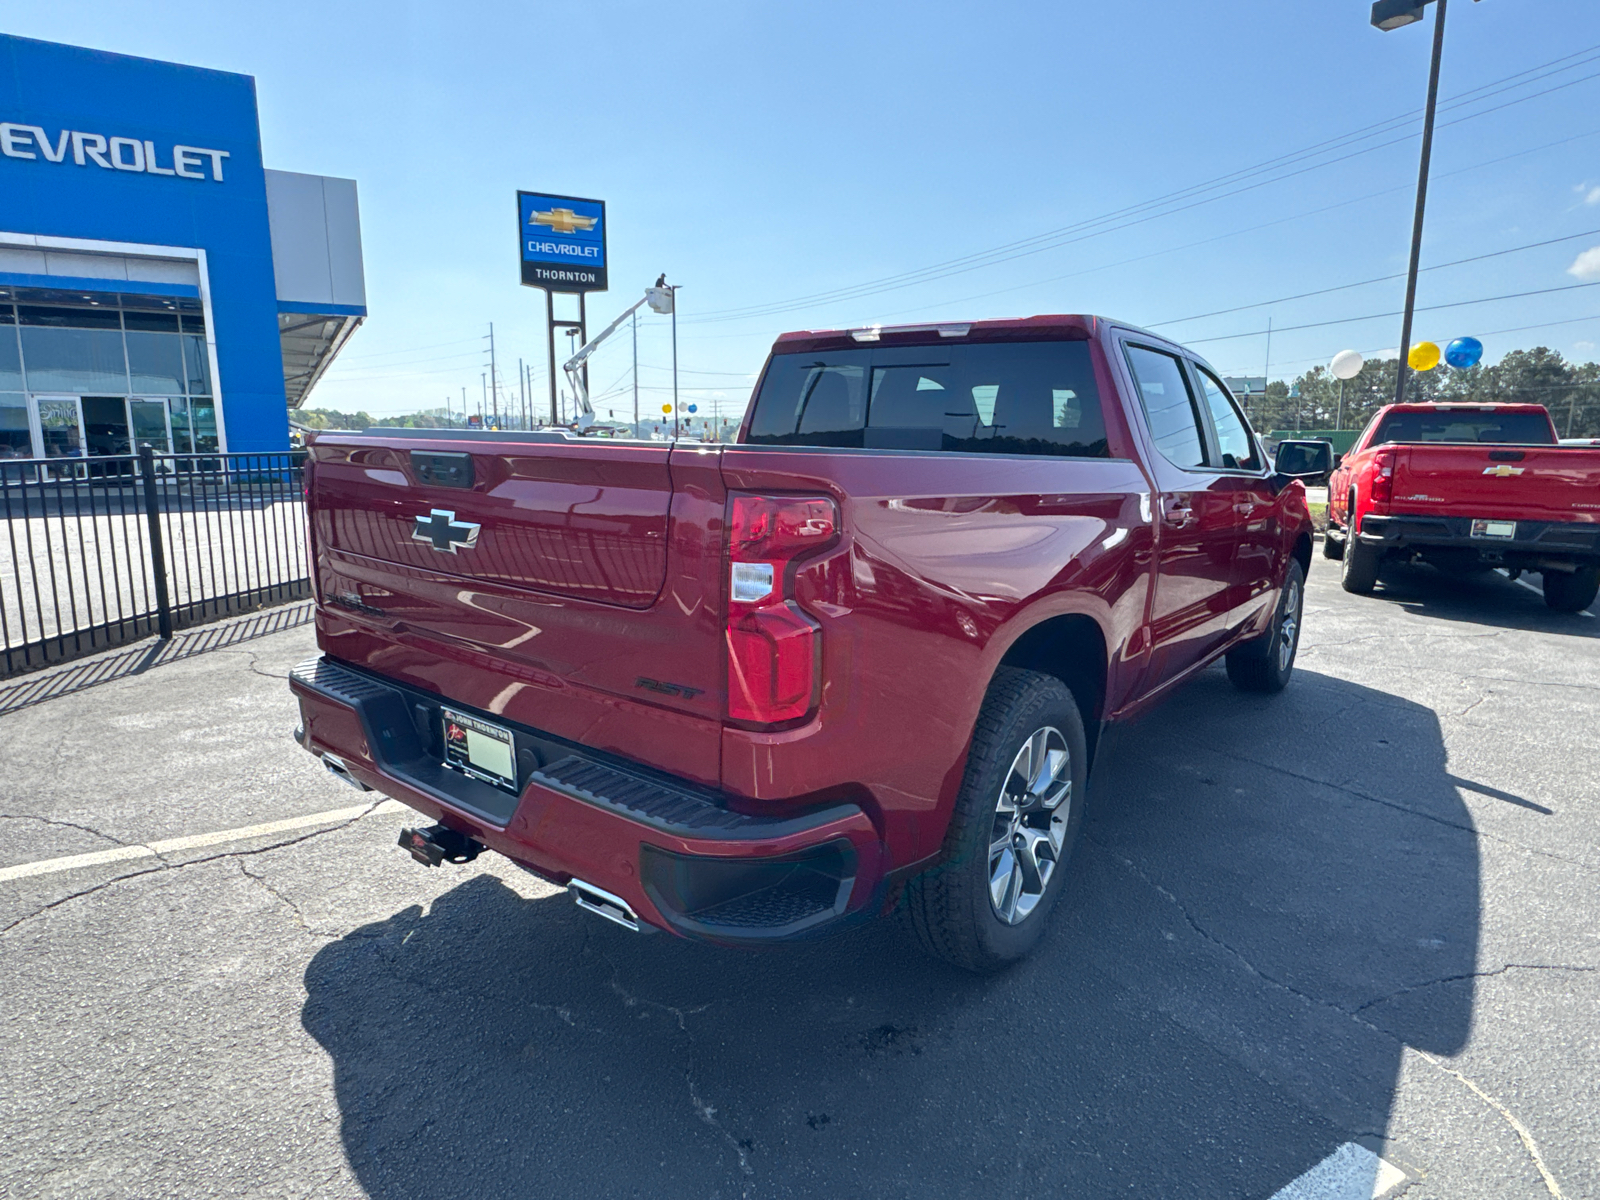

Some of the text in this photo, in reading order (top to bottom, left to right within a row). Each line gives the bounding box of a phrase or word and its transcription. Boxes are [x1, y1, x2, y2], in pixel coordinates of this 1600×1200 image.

[528, 241, 599, 257] CHEVROLET
[535, 268, 596, 282] THORNTON
[634, 677, 705, 699] RST
[456, 715, 473, 727] JOHN
[473, 721, 509, 740] THORNTON
